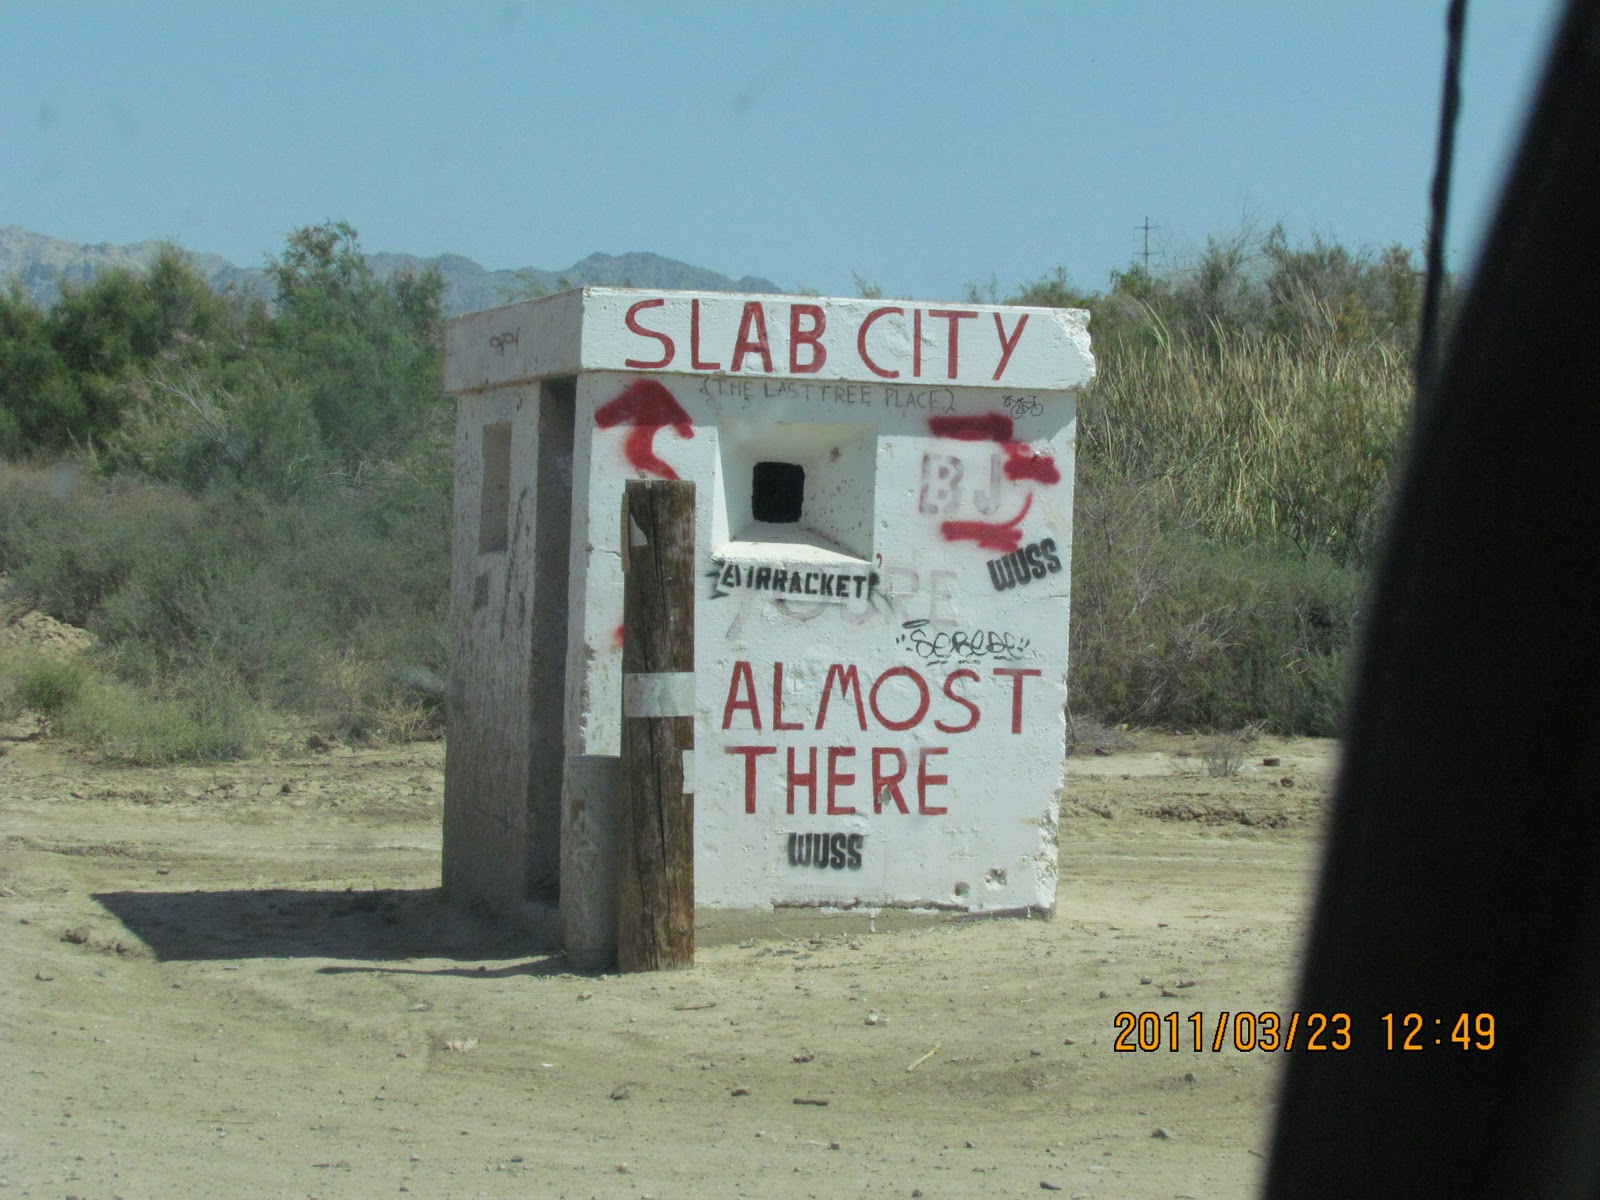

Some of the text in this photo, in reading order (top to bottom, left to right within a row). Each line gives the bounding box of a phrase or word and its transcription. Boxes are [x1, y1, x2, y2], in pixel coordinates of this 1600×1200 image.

[624, 298, 1029, 381] SLAB CITY
[763, 382, 812, 401] LAST
[816, 385, 872, 405] FREE
[986, 537, 1062, 592] WUSS
[722, 660, 1041, 734] ALMOST
[725, 746, 949, 815] THERE
[788, 832, 864, 870] WUSS
